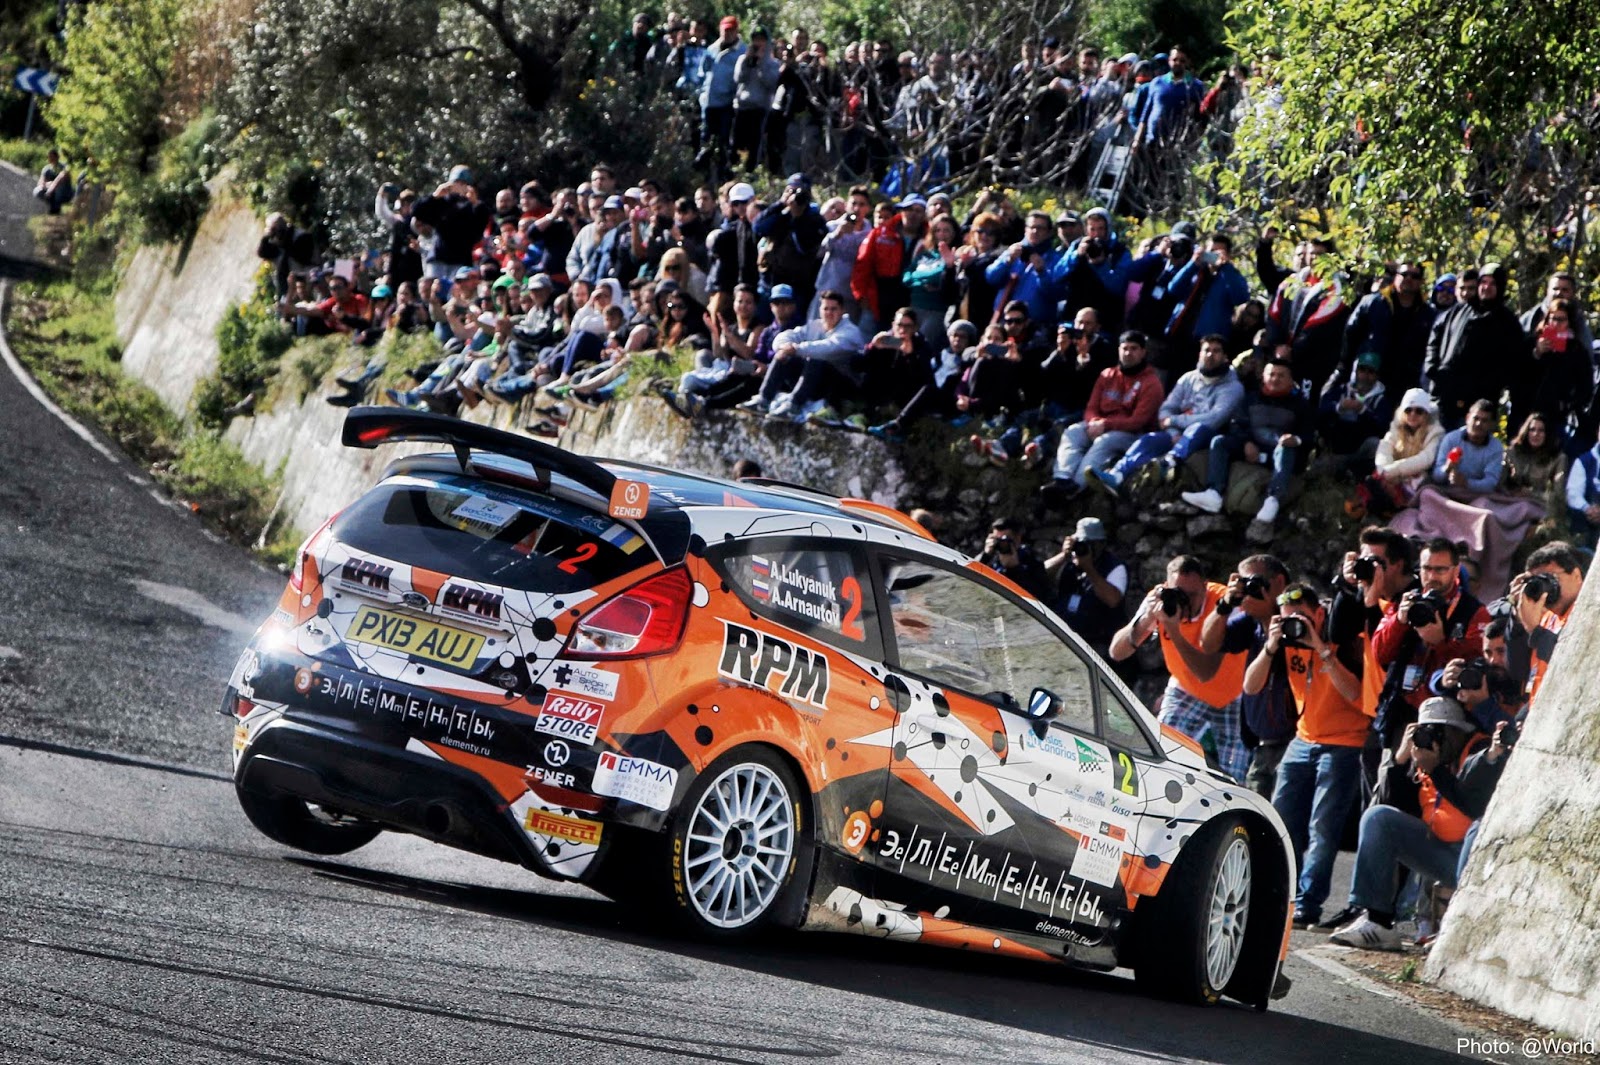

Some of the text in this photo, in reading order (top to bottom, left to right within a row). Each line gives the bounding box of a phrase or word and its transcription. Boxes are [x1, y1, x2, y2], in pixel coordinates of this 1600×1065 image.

[613, 506, 642, 517] ZENER
[557, 542, 598, 574] 2
[341, 557, 394, 591] RPM
[770, 561, 836, 600] A.Lukyanuk
[443, 583, 504, 620] RPM
[771, 586, 840, 628] A.Arnautov
[841, 576, 866, 642] 2
[356, 611, 476, 663] PX13 AUJ
[574, 668, 599, 679] AUTO
[718, 620, 830, 709] RPM
[547, 697, 599, 722] Rally
[537, 715, 597, 739] STORE
[440, 733, 492, 757] elementy.ru
[1040, 743, 1076, 761] Canarias
[524, 764, 576, 787] ZENER
[618, 758, 673, 786] EMMA
[1118, 752, 1134, 795] 2
[530, 812, 599, 841] PIRELLI
[1090, 837, 1120, 861] EMMA
[673, 838, 683, 894] ZERO
